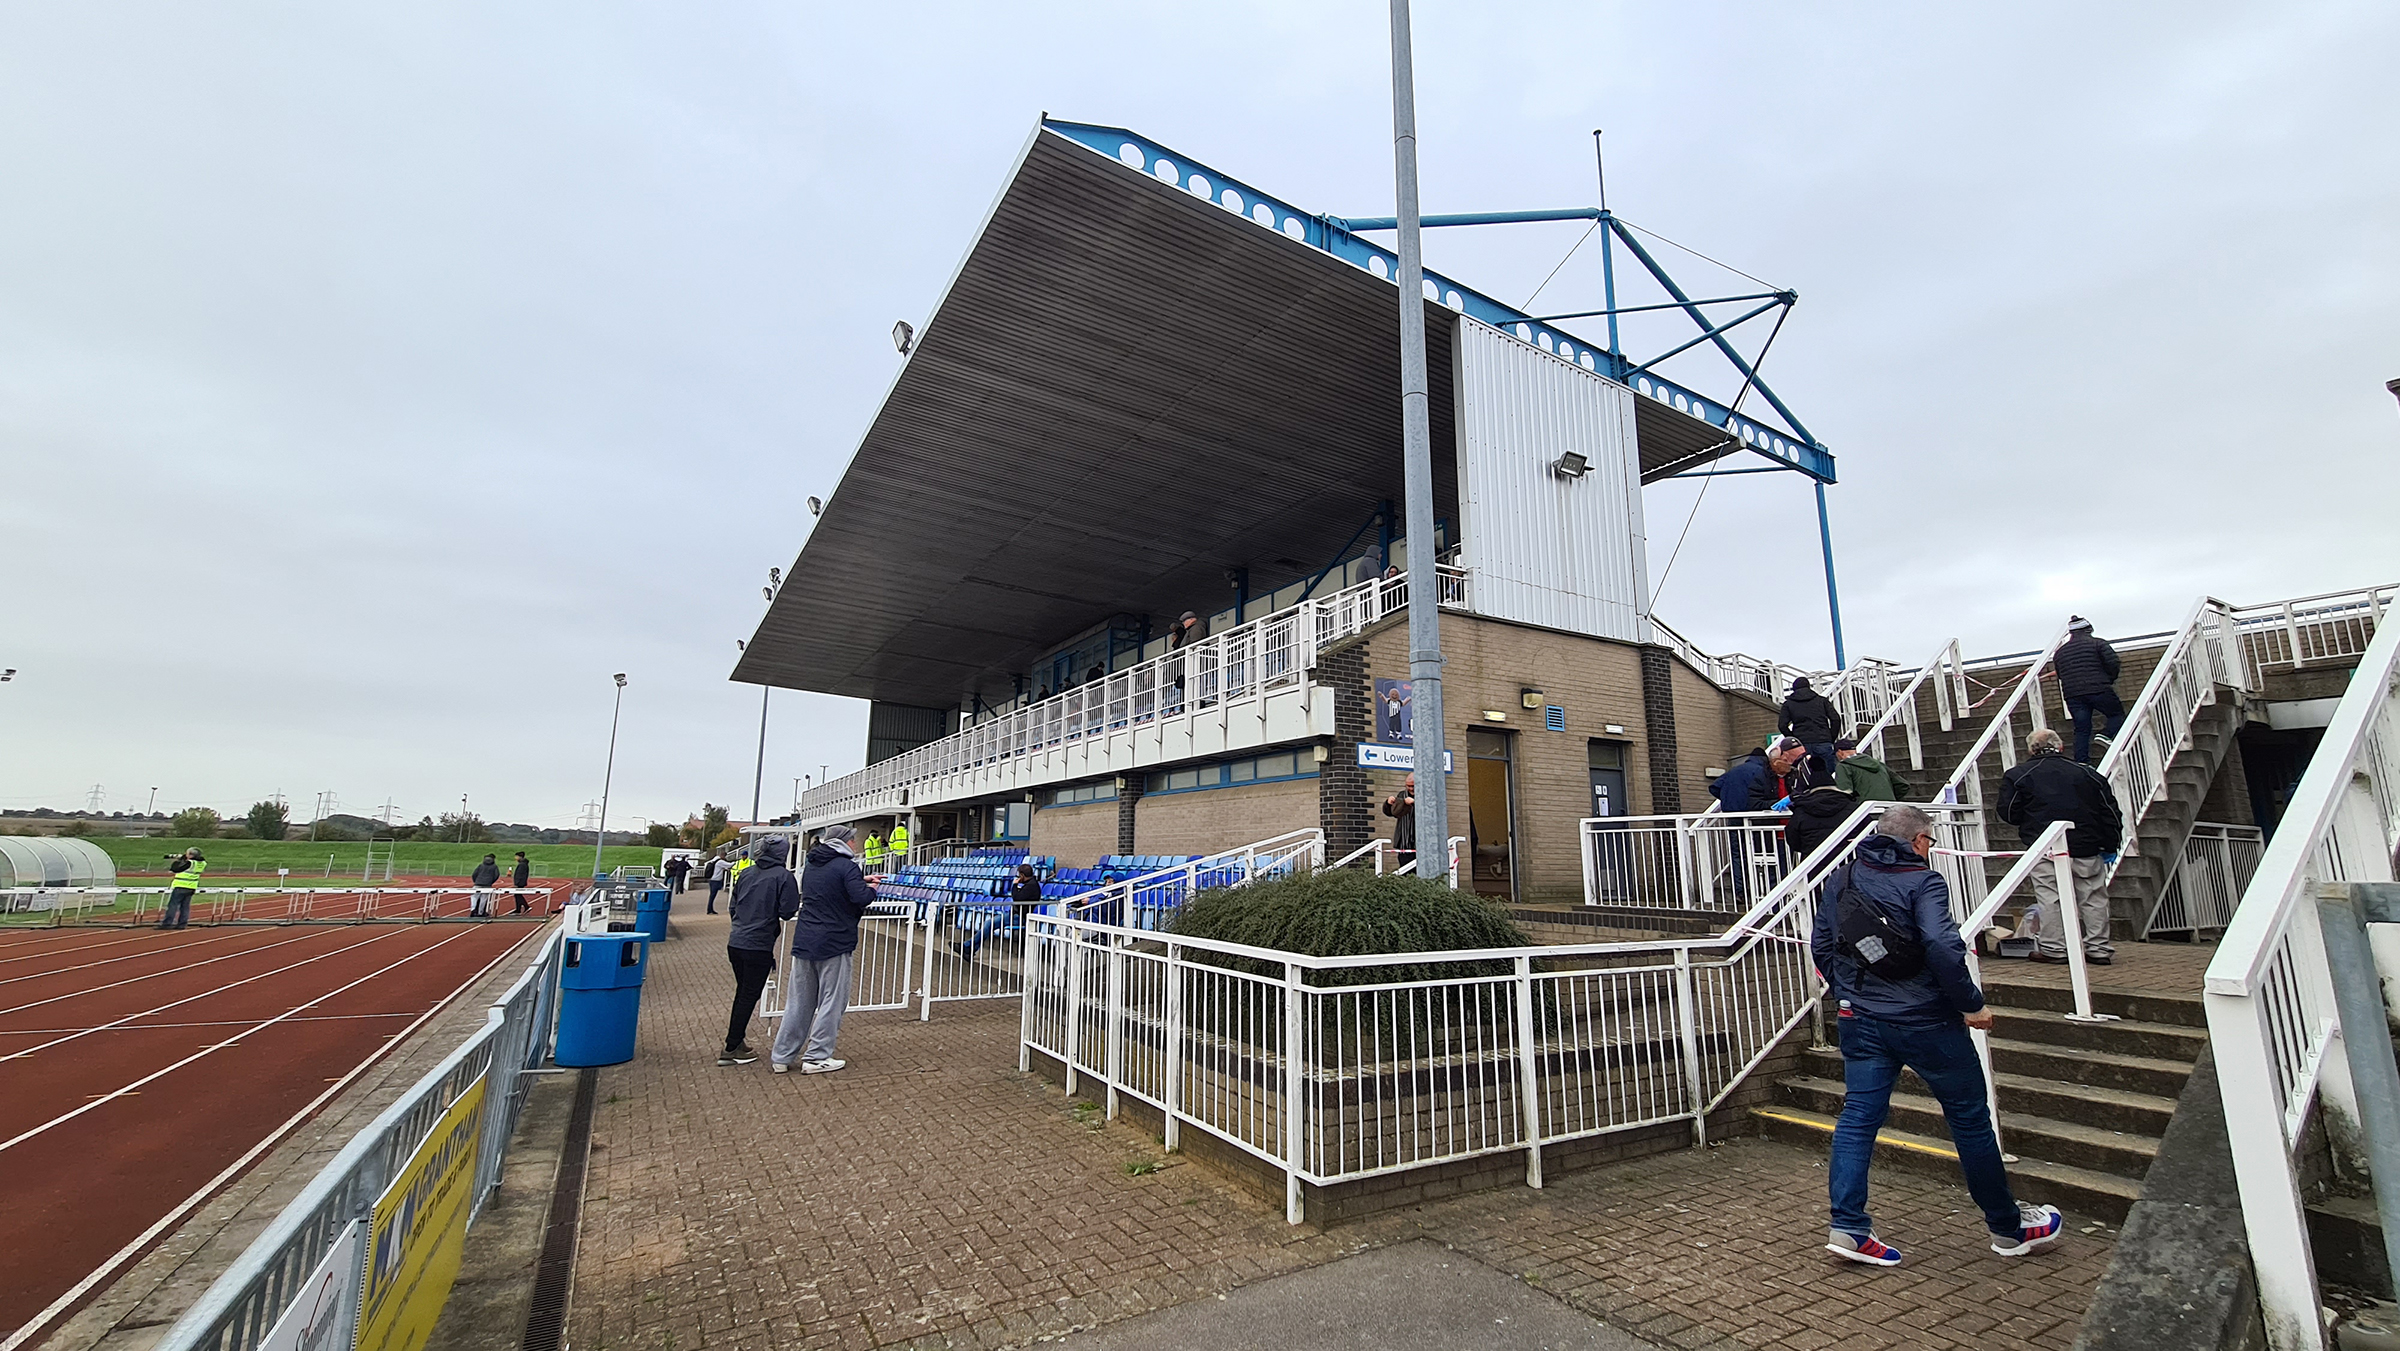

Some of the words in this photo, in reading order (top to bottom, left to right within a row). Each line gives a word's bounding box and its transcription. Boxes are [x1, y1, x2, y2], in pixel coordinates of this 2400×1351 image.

[1383, 751, 1415, 764] Lower
[417, 1098, 481, 1212] GRANTHAM
[368, 1177, 419, 1302] MKM
